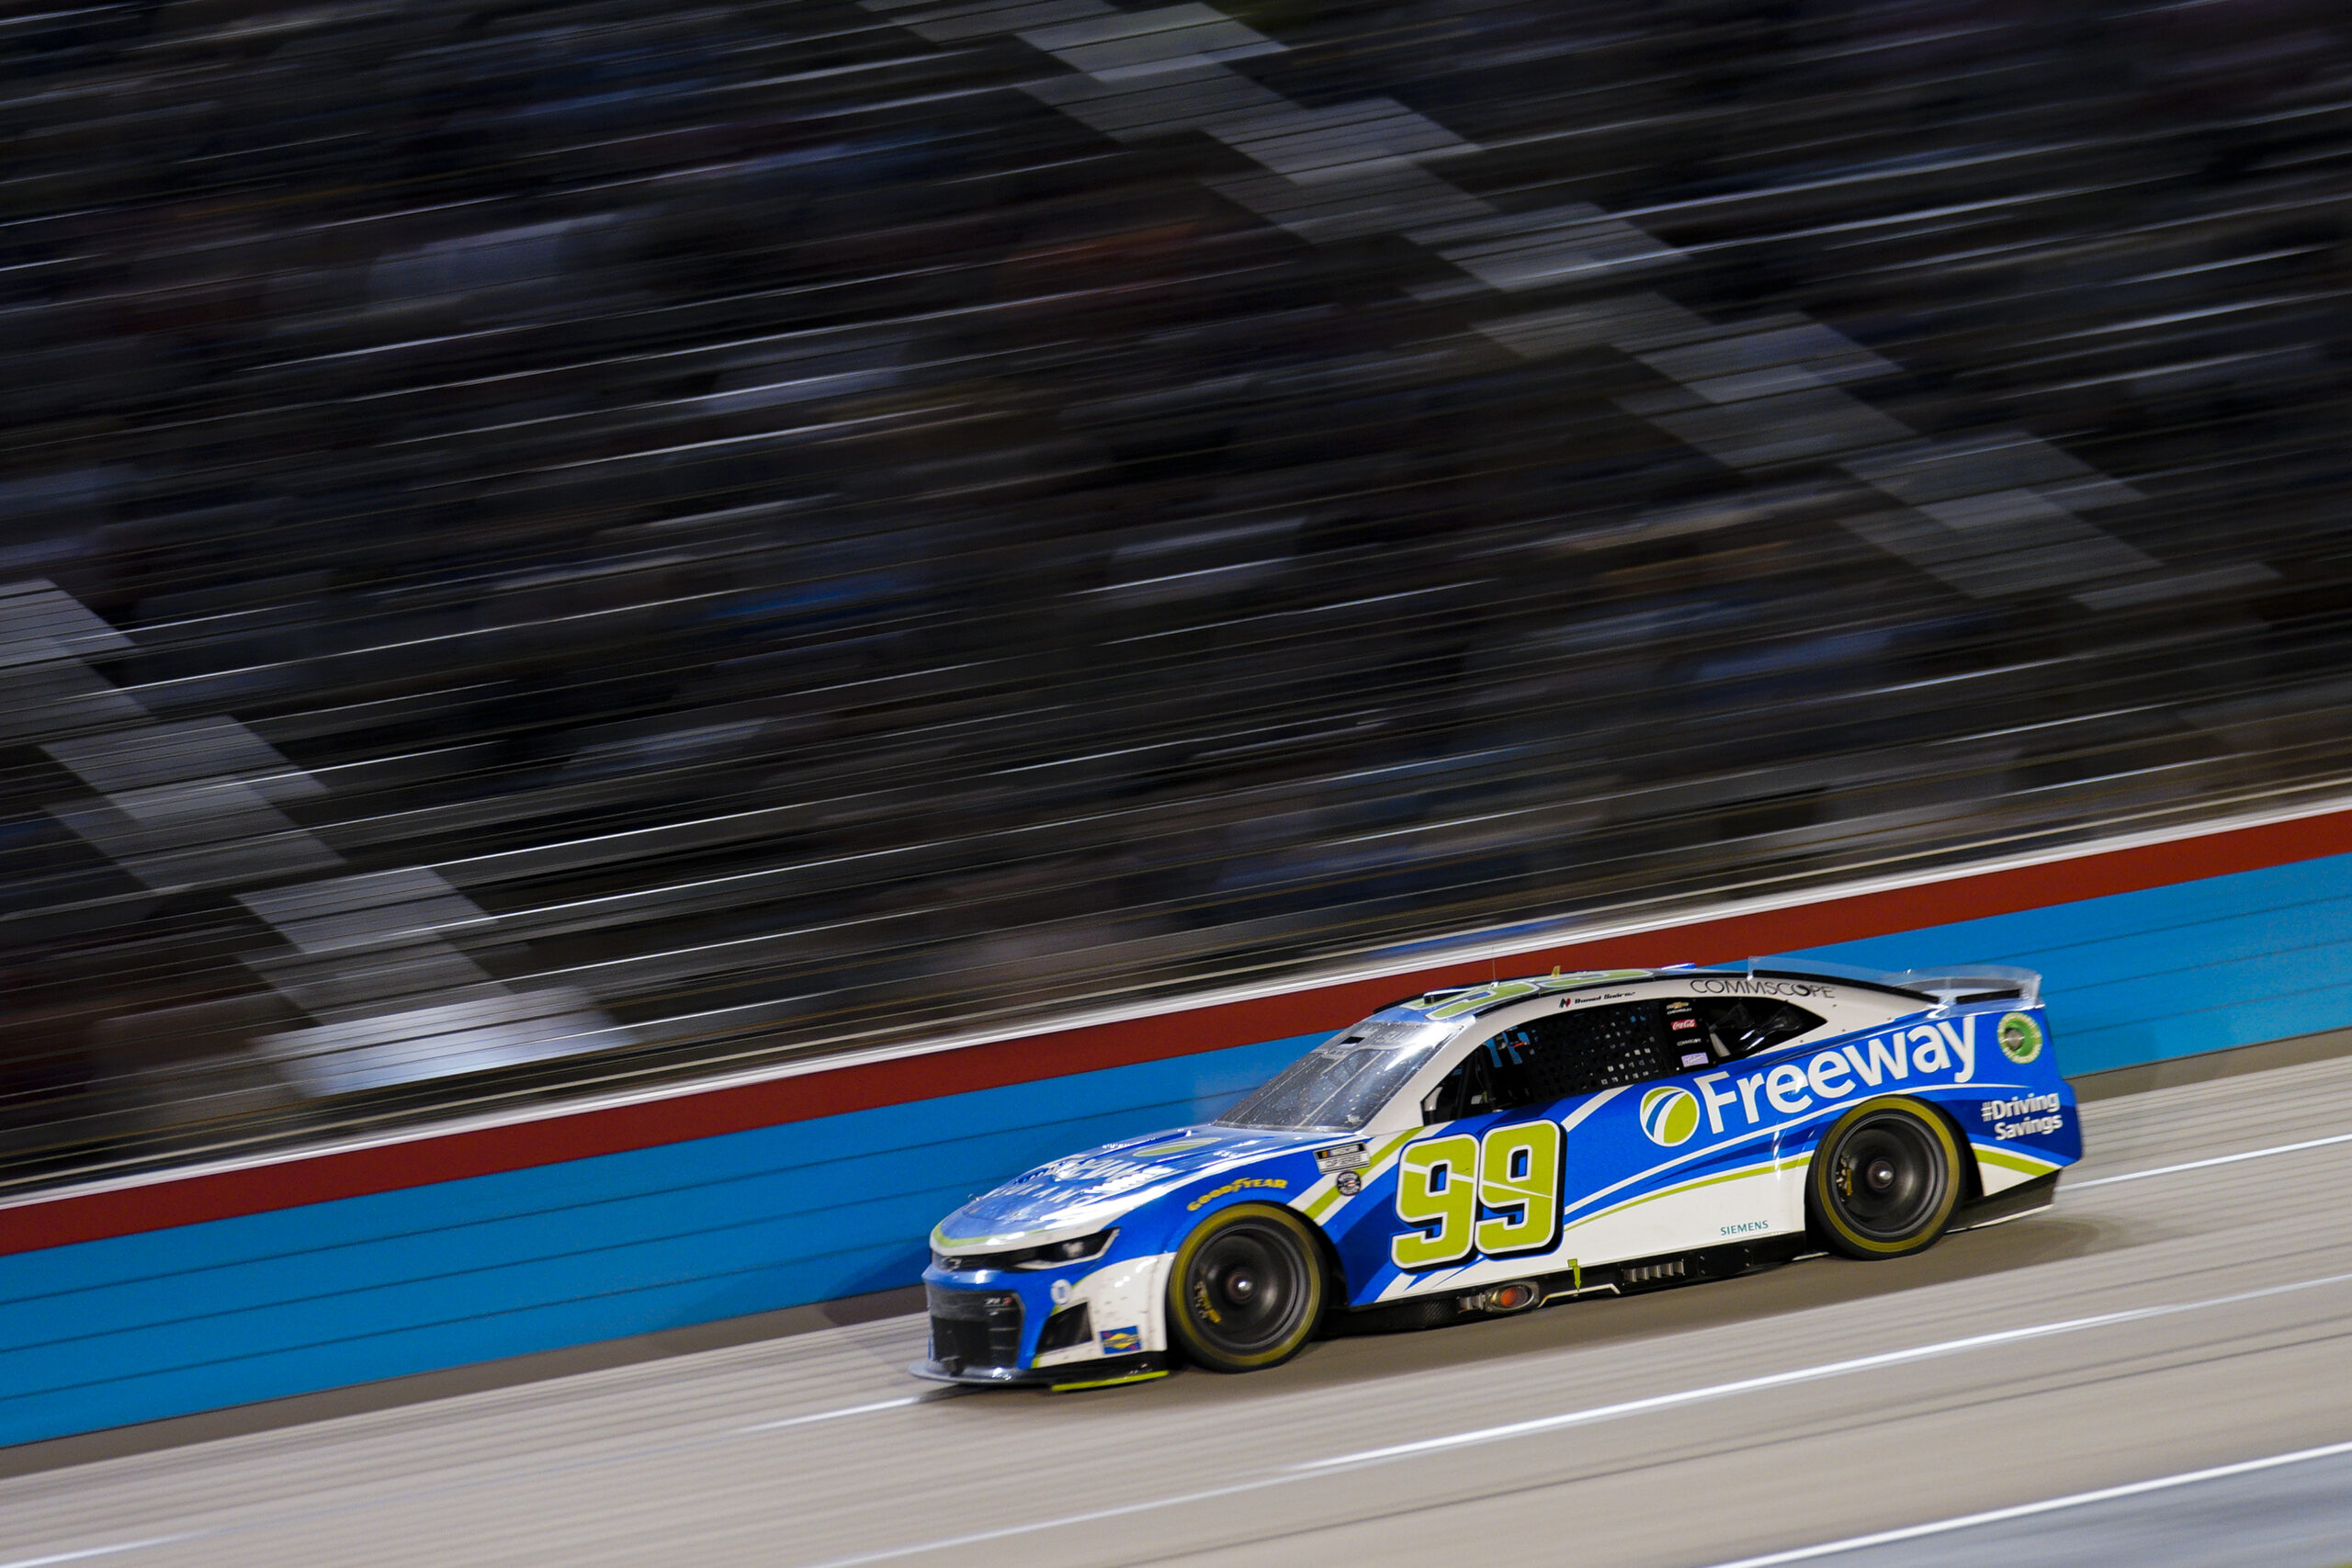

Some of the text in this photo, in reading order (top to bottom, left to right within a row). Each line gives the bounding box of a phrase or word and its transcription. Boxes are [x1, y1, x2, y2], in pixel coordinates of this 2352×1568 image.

[1690, 978, 1836, 998] COMMSCOPE
[1693, 1017, 1975, 1134] Freeway
[1981, 1092, 2061, 1122] #Driving
[1994, 1114, 2063, 1141] Savings
[1187, 1177, 1288, 1212] GOODYEAR
[1391, 1119, 1565, 1270] 99
[1720, 1220, 1769, 1236] SIEMENS
